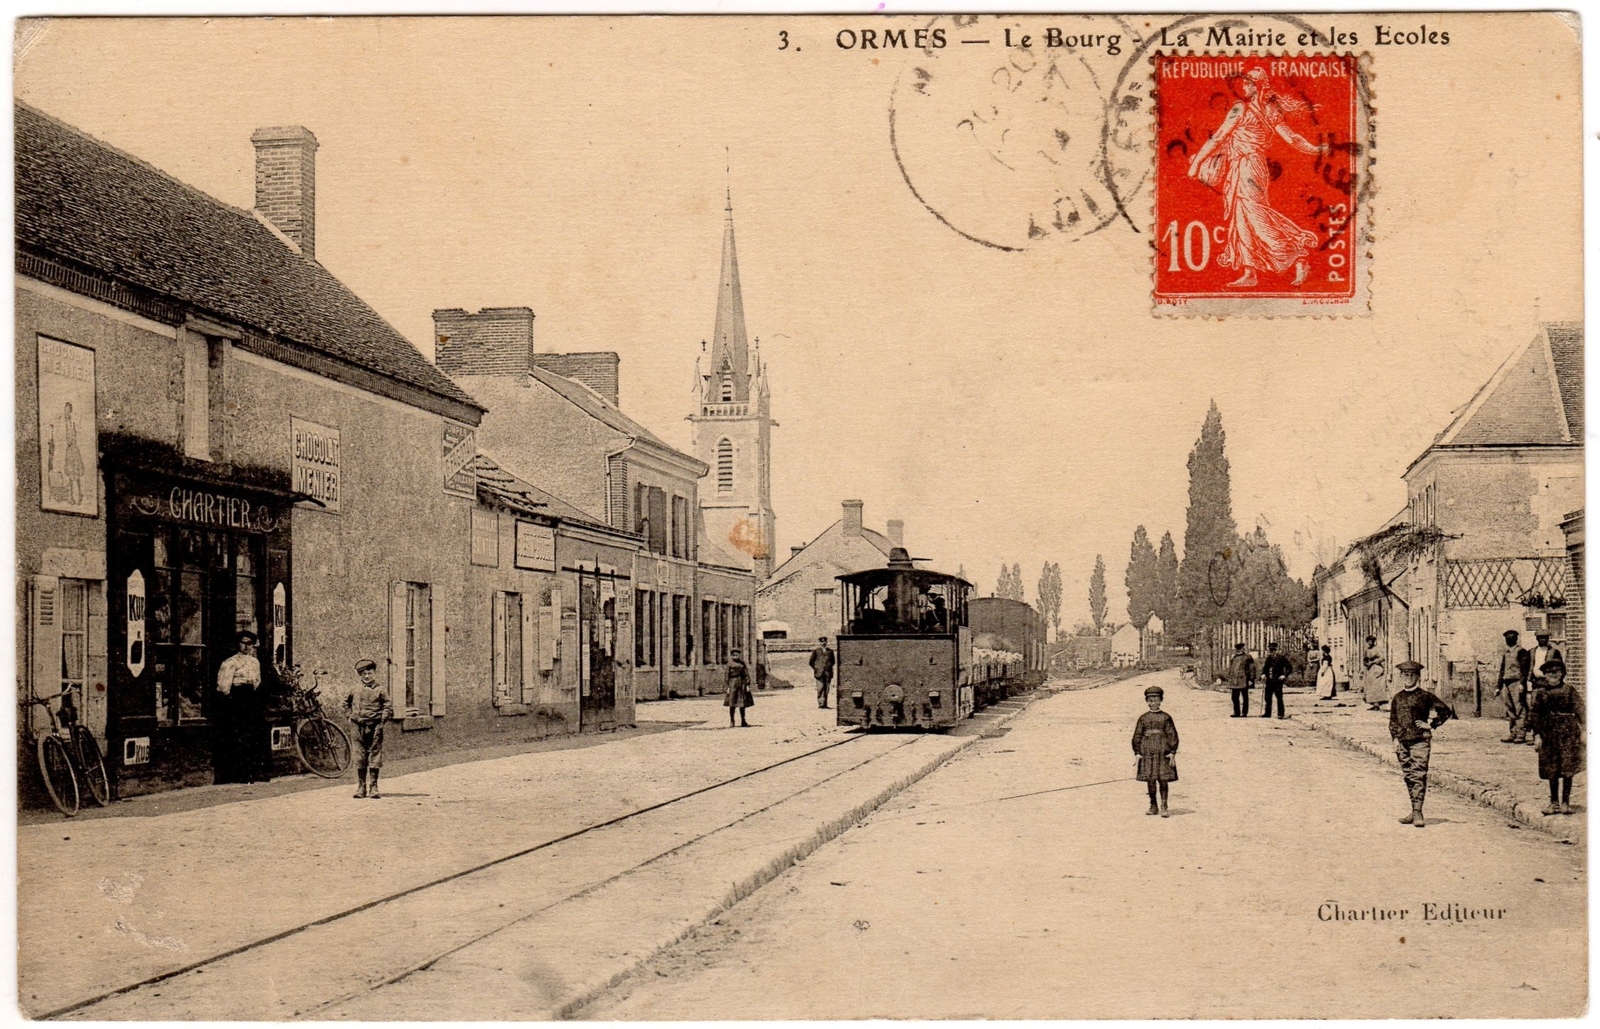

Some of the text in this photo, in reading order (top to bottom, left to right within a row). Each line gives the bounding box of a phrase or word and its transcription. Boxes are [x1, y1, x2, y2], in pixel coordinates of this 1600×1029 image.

[1271, 61, 1348, 79] FRANÇAISE
[1328, 203, 1347, 282] POSTES
[295, 428, 339, 468] CHOCOLAT
[297, 465, 338, 502] MENIER
[169, 486, 251, 529] CHARTIER
